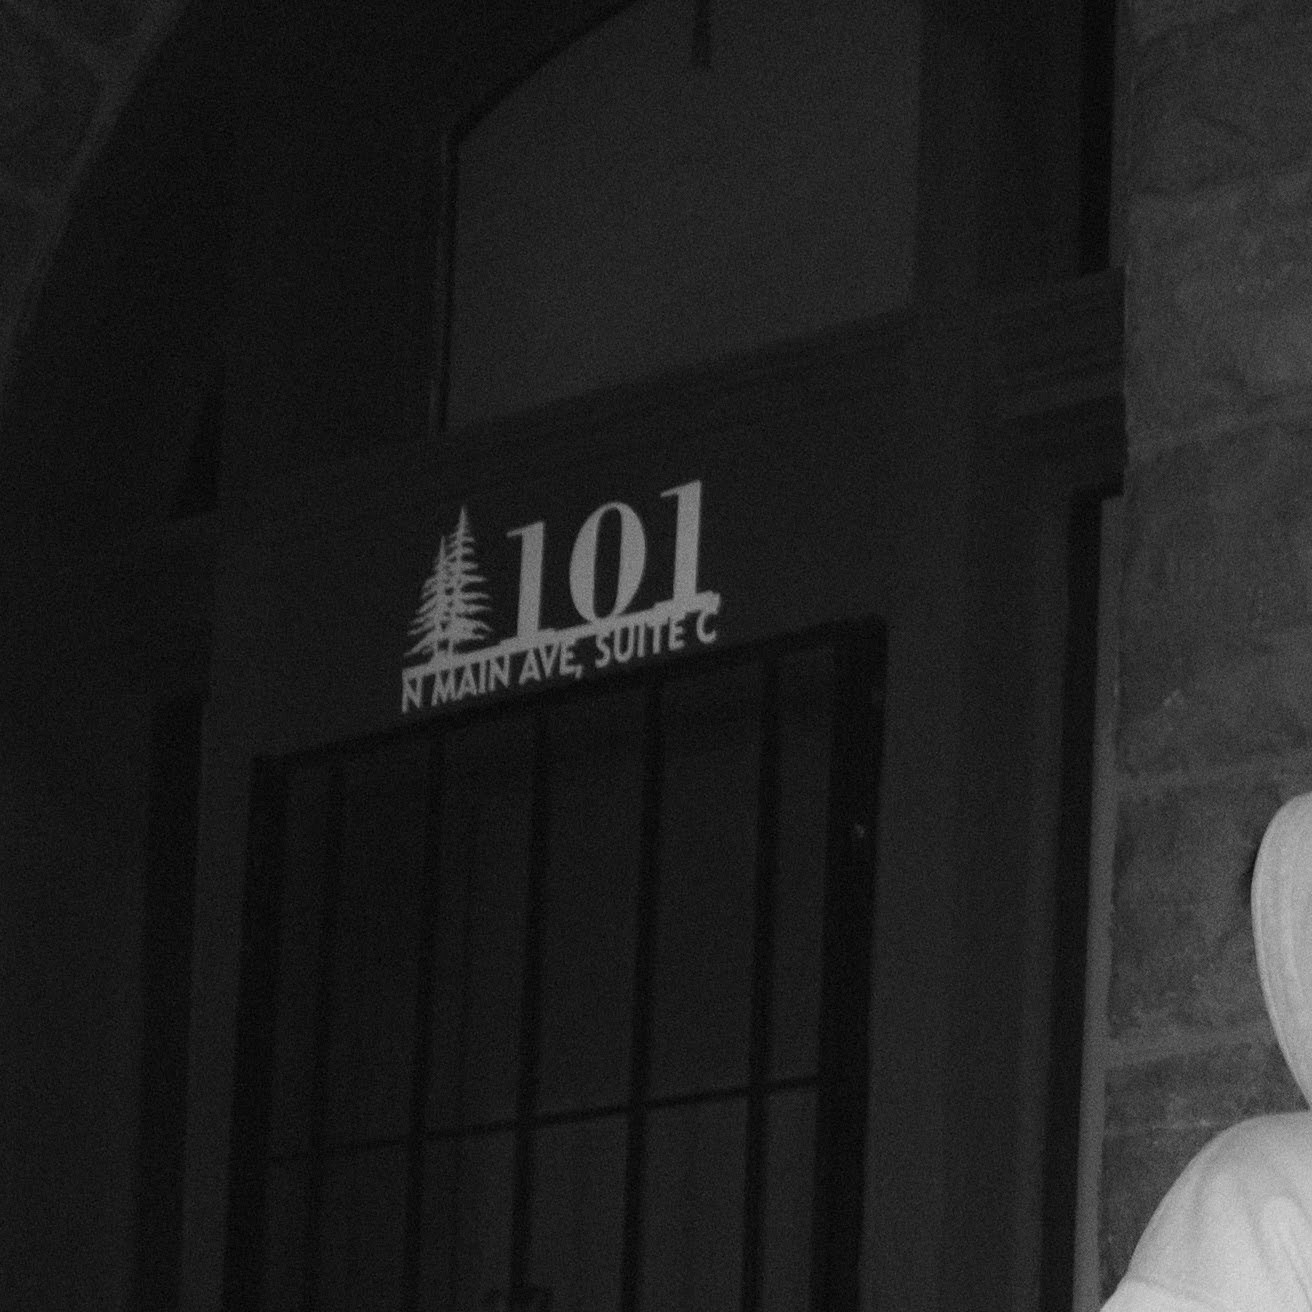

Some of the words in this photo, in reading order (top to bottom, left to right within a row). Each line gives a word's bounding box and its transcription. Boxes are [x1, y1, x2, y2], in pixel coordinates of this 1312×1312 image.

[506, 479, 706, 641] 101
[401, 672, 423, 713] N
[431, 655, 511, 707] MAIN
[518, 643, 584, 686] AVE,
[594, 616, 686, 668] SUITE
[696, 606, 718, 644] C
